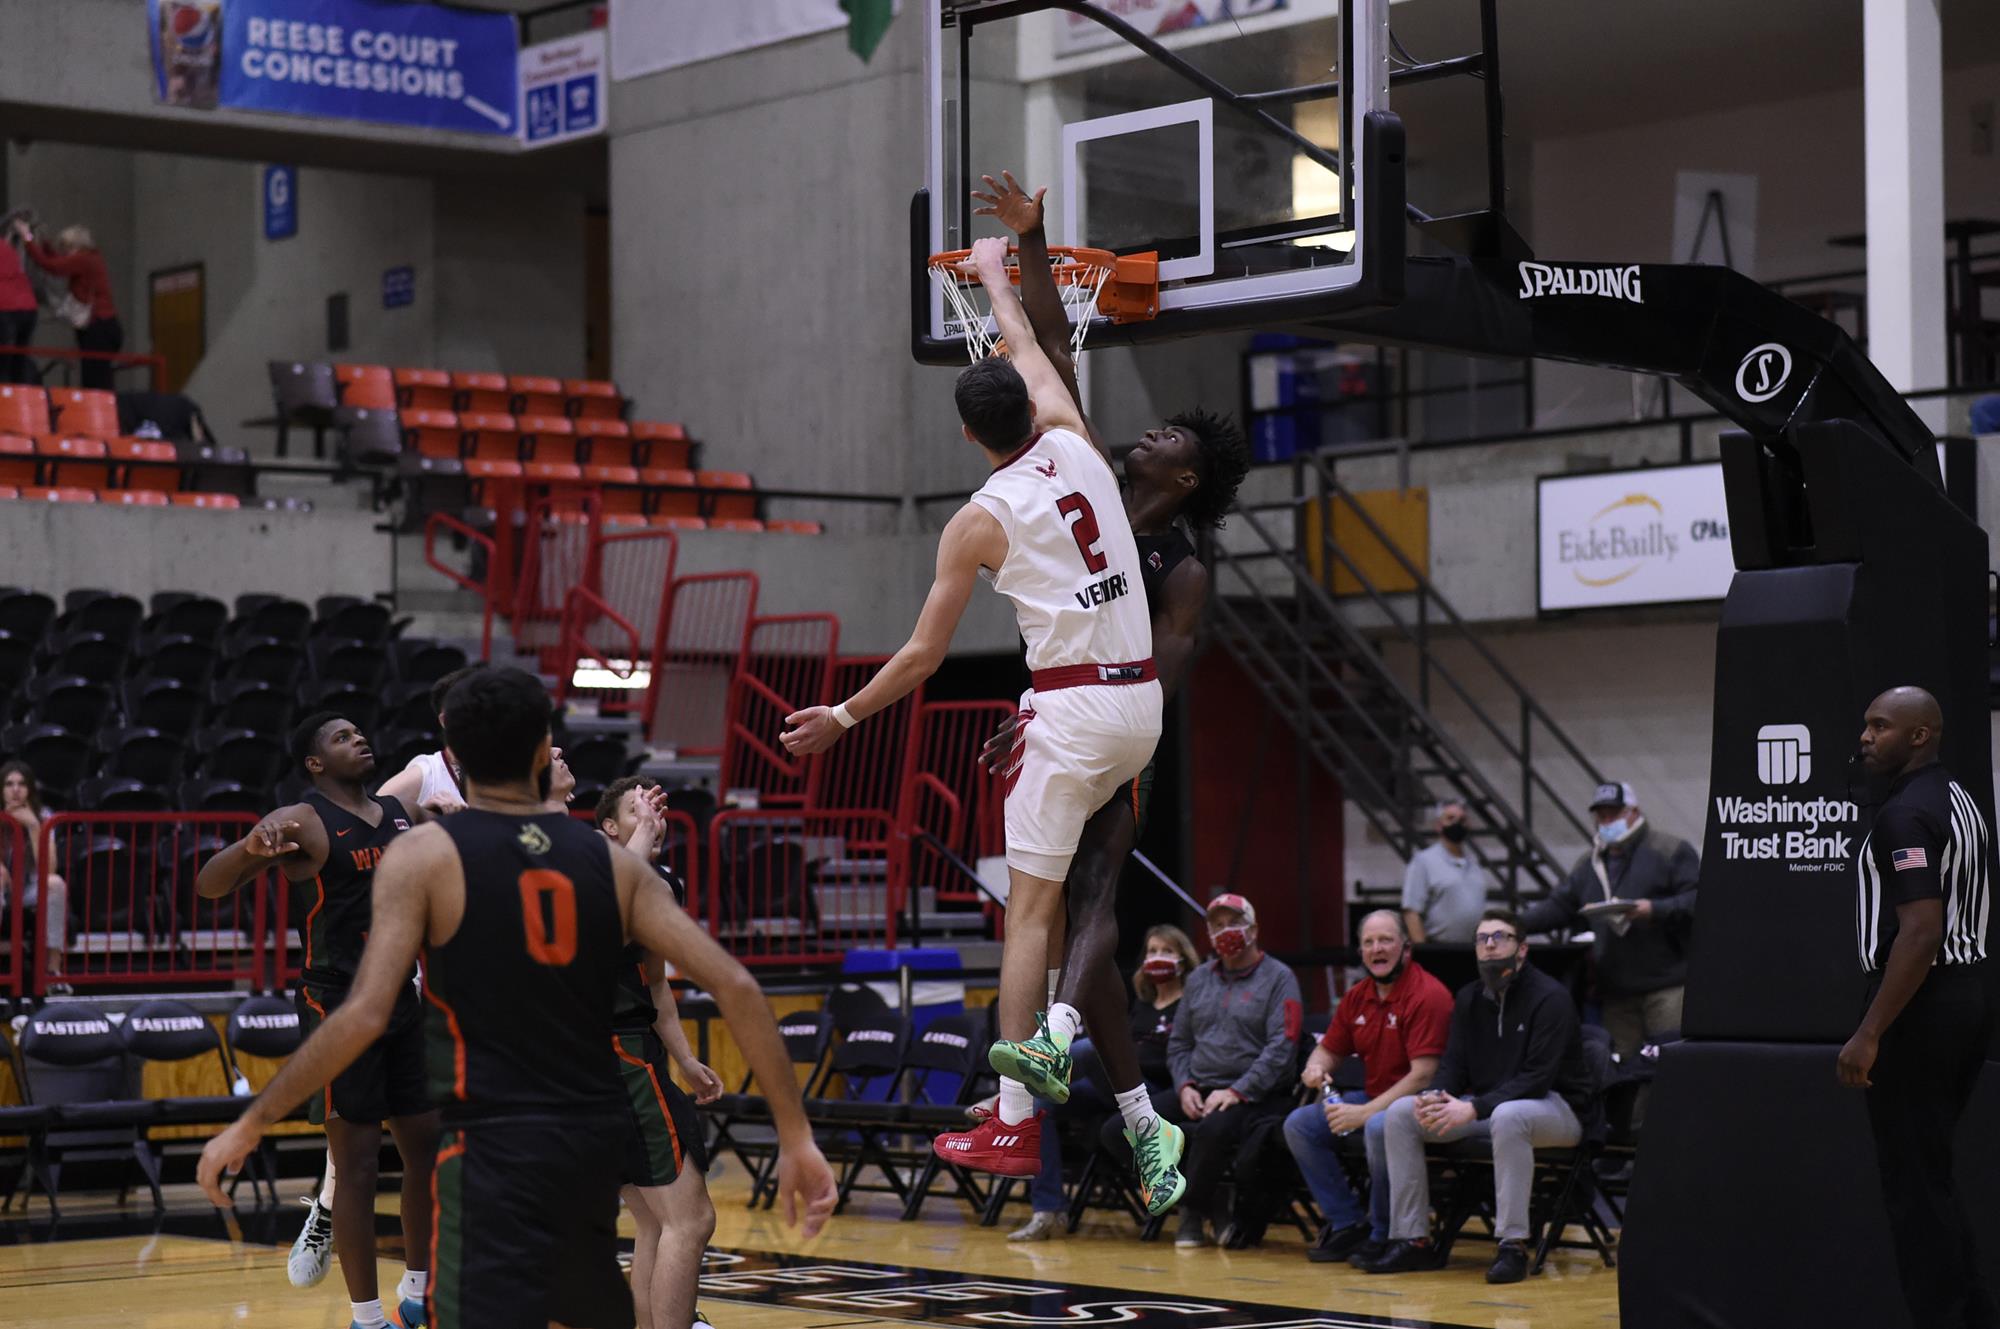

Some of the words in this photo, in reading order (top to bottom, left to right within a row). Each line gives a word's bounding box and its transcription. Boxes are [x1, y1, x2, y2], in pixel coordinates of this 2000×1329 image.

[248, 17, 344, 54] REESE
[352, 30, 458, 66] COURT
[242, 50, 465, 99] CONCESSIONS
[269, 169, 289, 205] G
[1519, 261, 1642, 303] SPALDING
[1056, 491, 1108, 576] 2
[1716, 795, 1858, 834] Washington
[1721, 832, 1781, 859] Trust
[1785, 831, 1851, 859] Bank
[1789, 863, 1822, 872] Member
[1823, 863, 1846, 872] FDIC
[518, 869, 577, 966] 0
[34, 1020, 110, 1036] EASTERN
[131, 1017, 204, 1033] EASTERN
[237, 1013, 299, 1029] EASTERN
